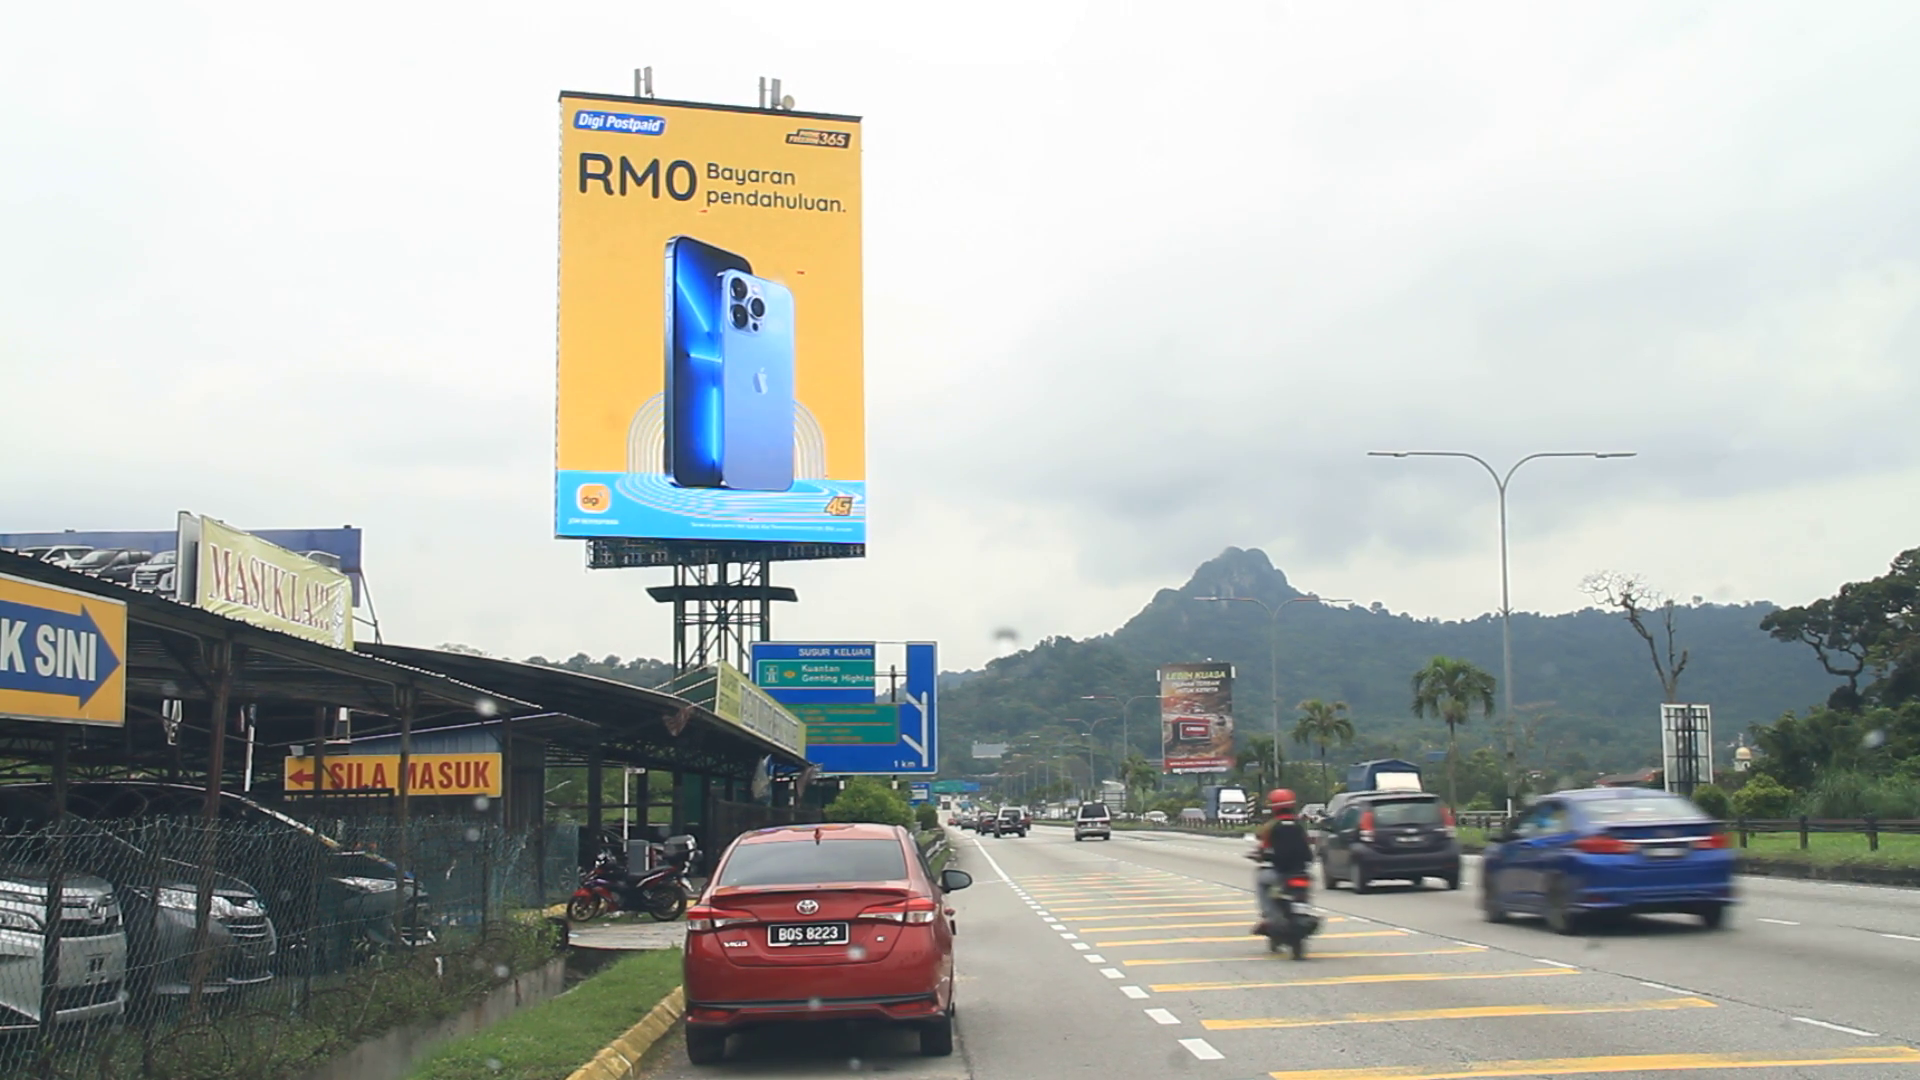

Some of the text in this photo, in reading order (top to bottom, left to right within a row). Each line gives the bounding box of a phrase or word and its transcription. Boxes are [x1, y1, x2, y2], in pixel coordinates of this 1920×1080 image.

[578, 113, 661, 133] Digi Postpaid
[820, 132, 846, 146] 365
[706, 162, 796, 186] Bayaran
[706, 188, 847, 213] pendahuluan.
[34, 623, 98, 682] SINI
[798, 648, 872, 657] SUSUR KELUAR
[801, 664, 841, 673] Kuantan
[1194, 670, 1226, 679] KUASA
[801, 674, 838, 683] Genting
[893, 760, 916, 768] 1 km
[329, 760, 490, 790] SILA MASUK
[806, 926, 838, 940] 8223
